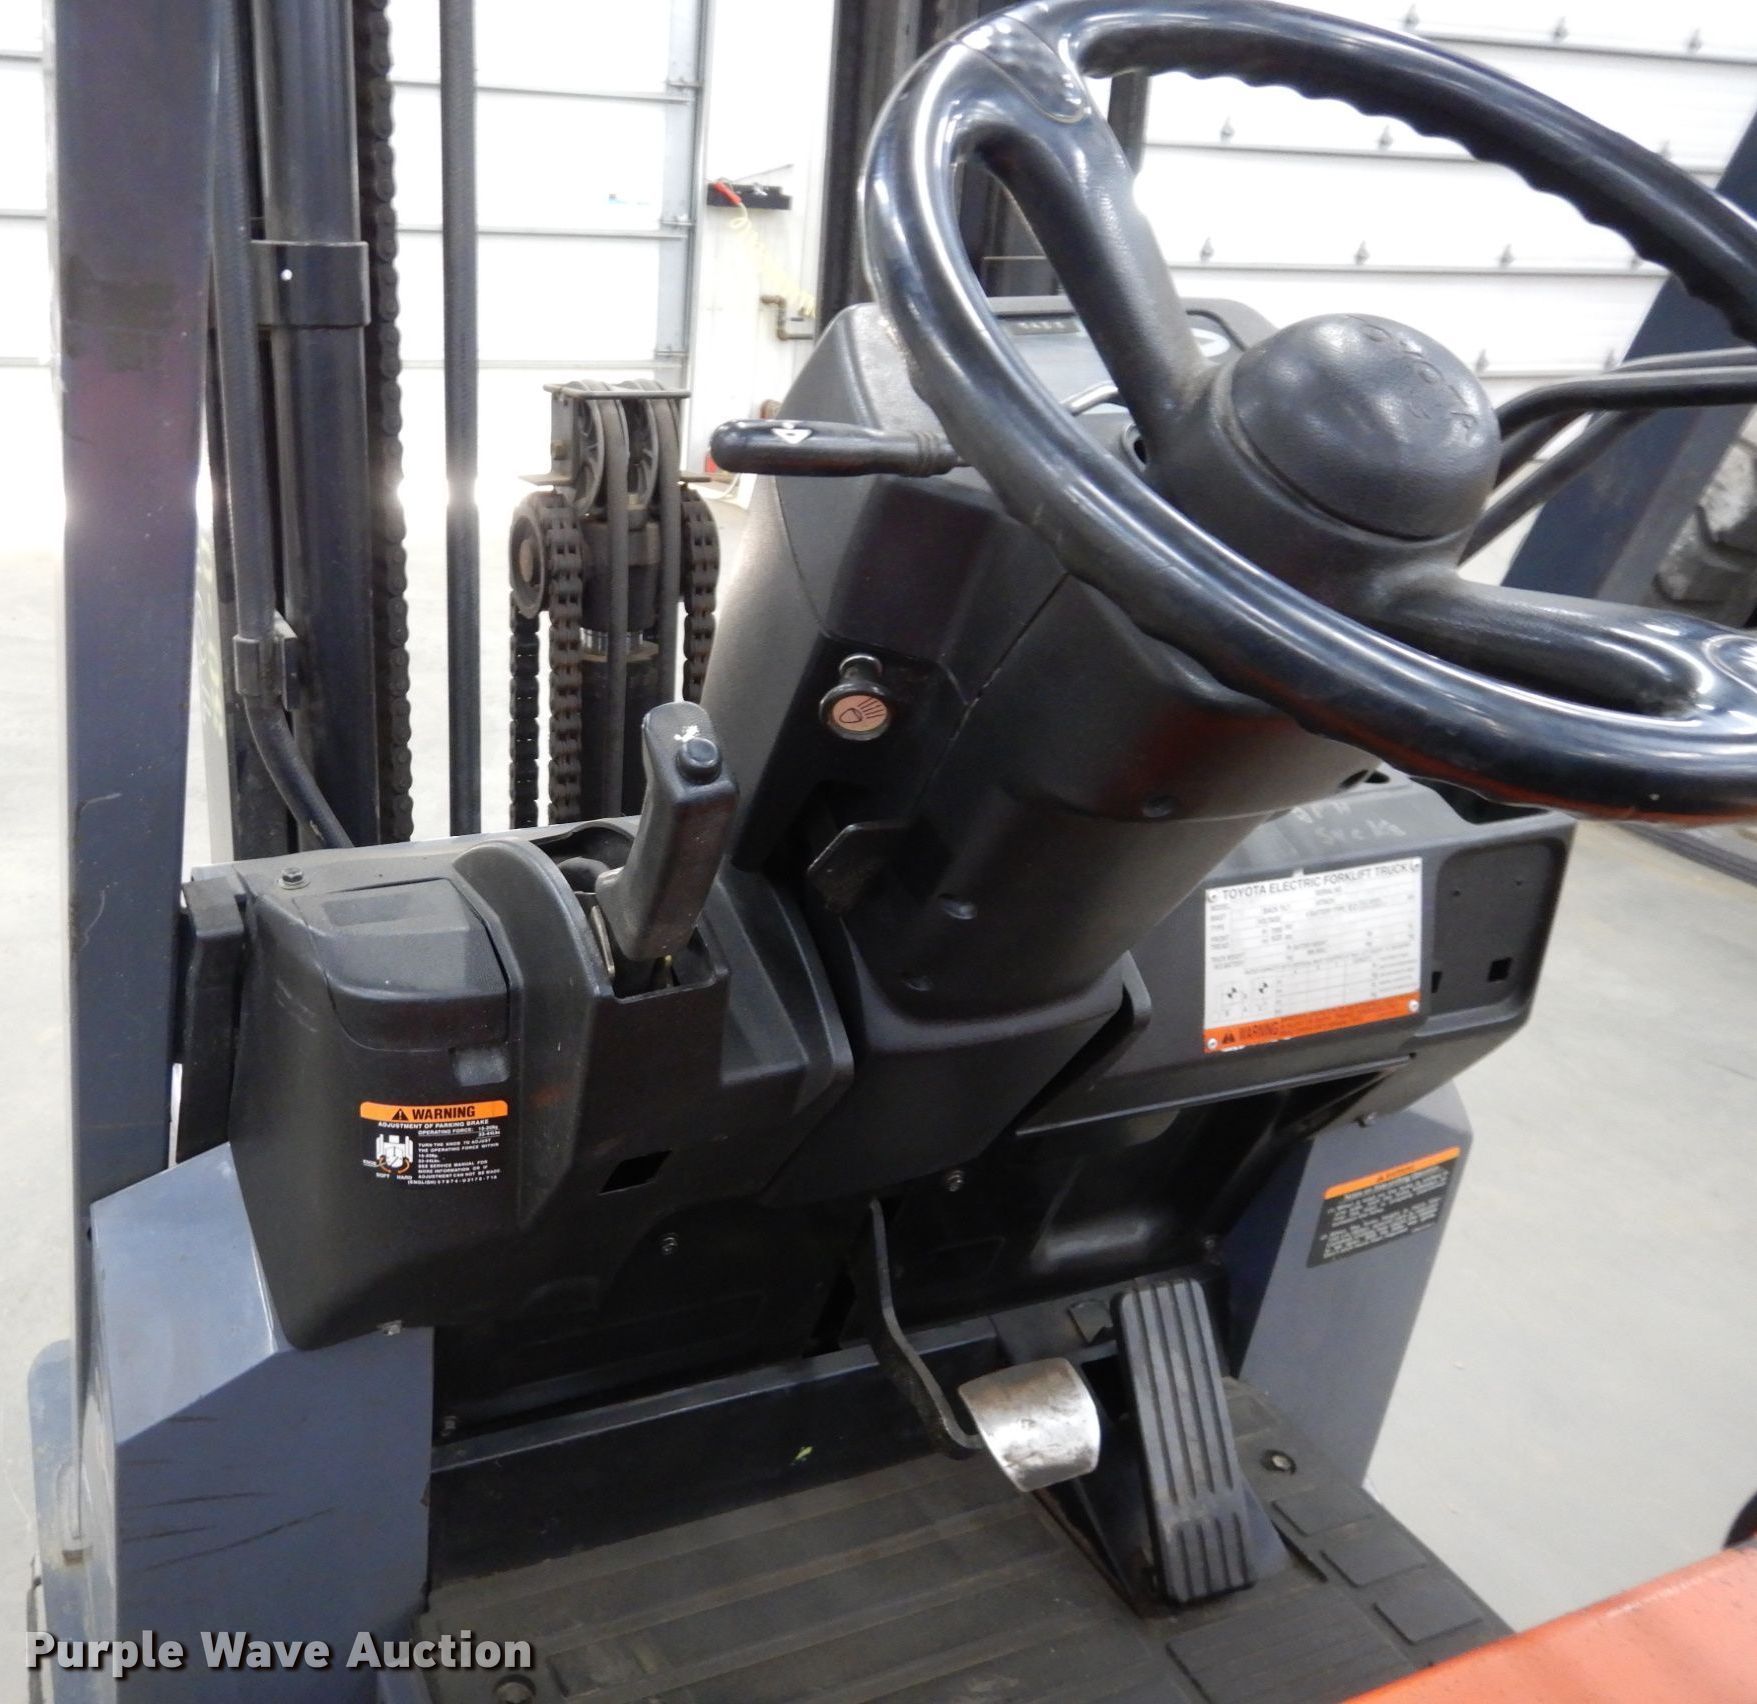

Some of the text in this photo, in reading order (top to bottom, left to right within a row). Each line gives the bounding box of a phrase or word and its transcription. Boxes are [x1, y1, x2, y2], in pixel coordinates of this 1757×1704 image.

[1222, 886, 1267, 900] TOYOTA
[1269, 878, 1321, 895] ELECTRIC
[1323, 867, 1373, 886] FORKLIFT
[1375, 862, 1409, 877] TRUCK
[412, 1105, 476, 1120] WARNING
[378, 1121, 423, 1129] ADJUSTMENT
[466, 1119, 489, 1127] BRAKE
